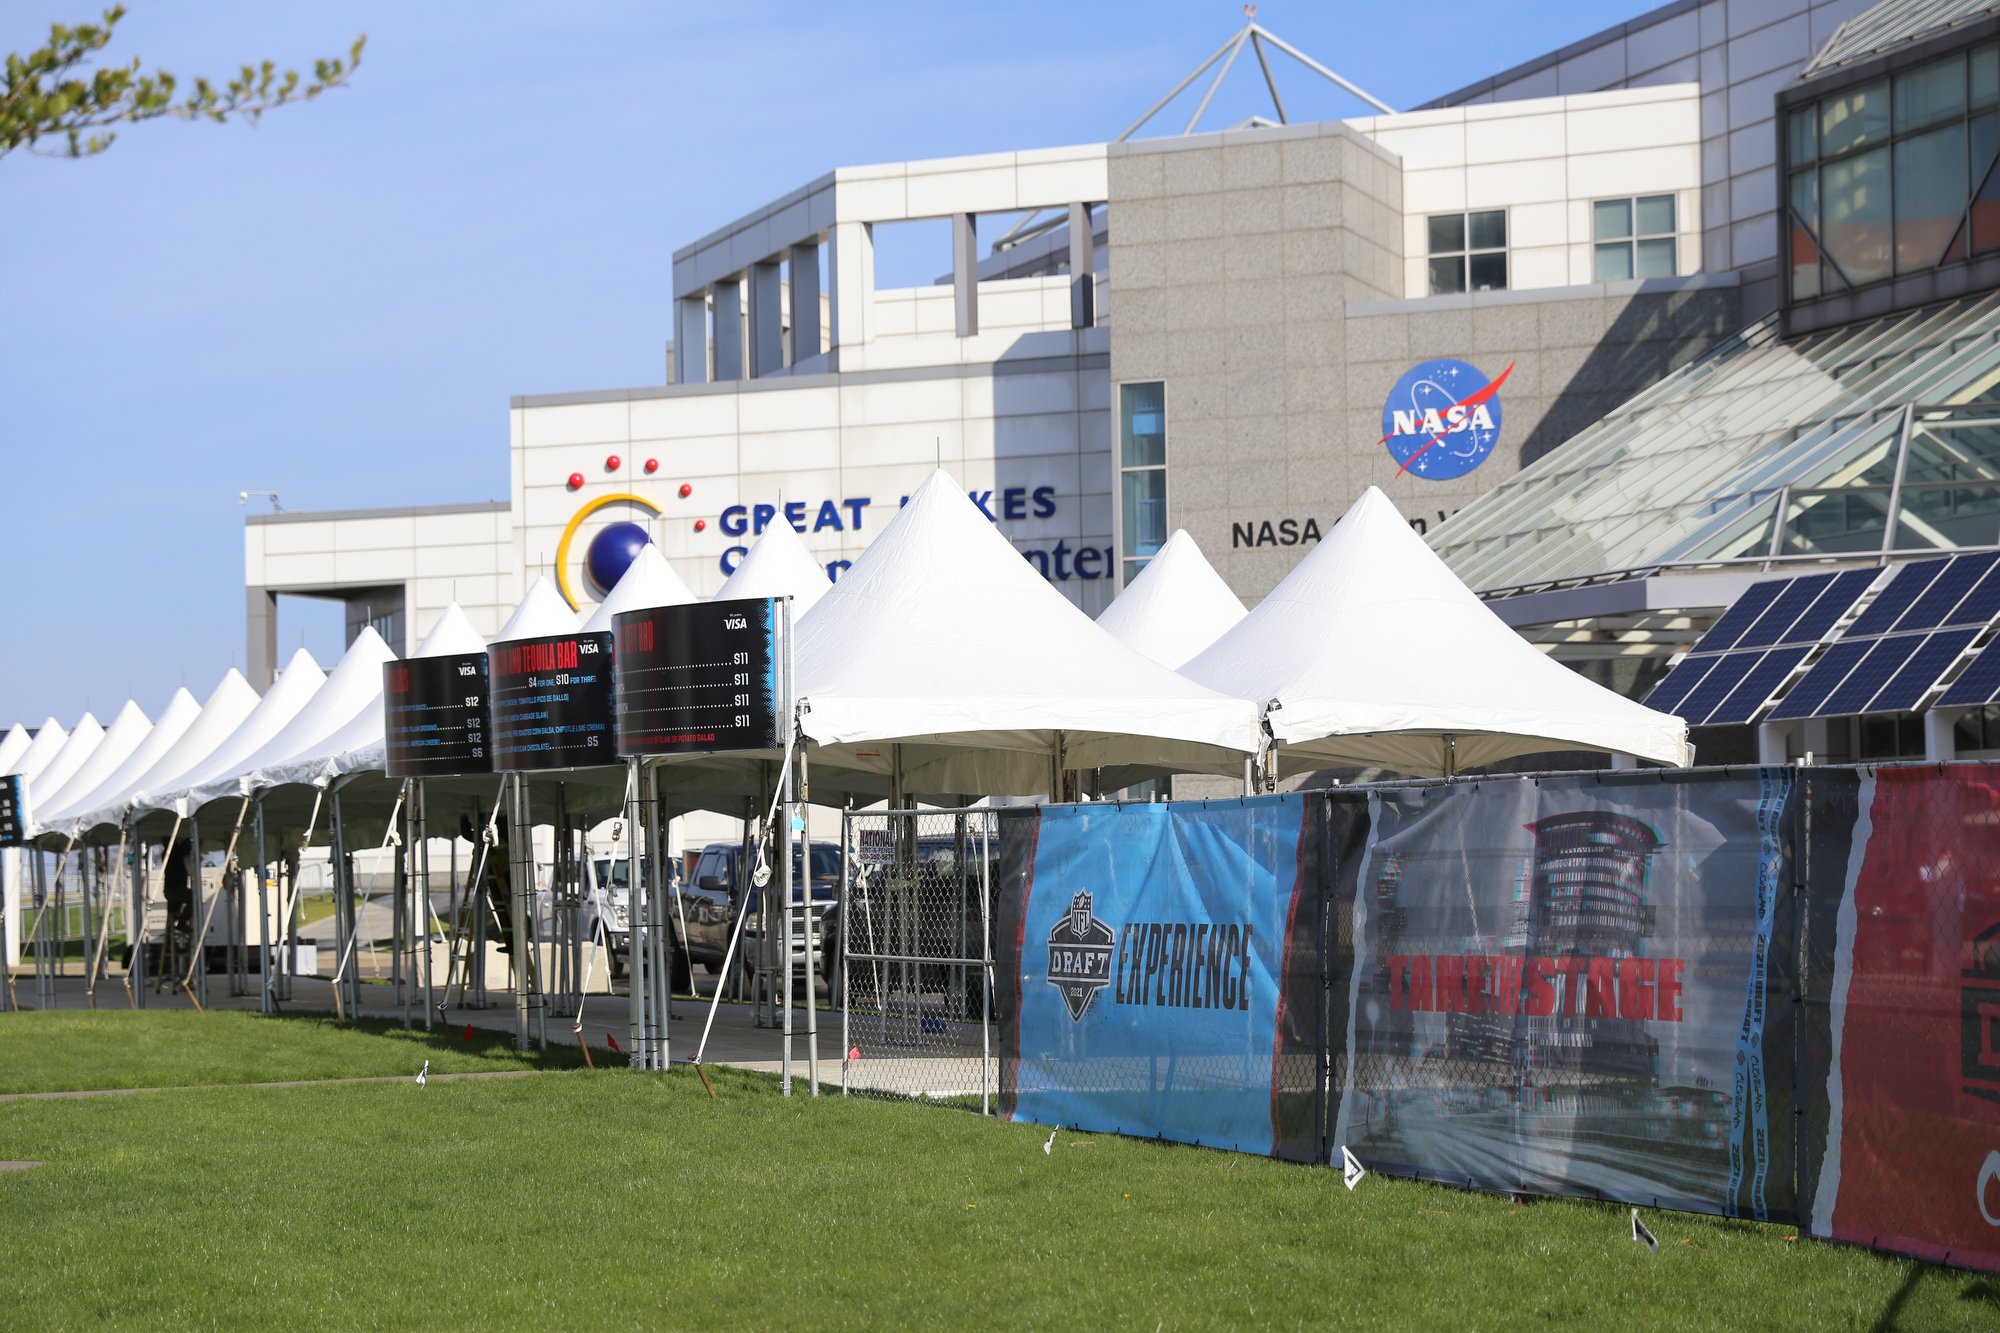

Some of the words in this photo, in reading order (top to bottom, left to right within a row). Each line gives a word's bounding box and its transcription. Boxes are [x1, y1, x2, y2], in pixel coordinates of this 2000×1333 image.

[1392, 404, 1495, 436] NASA
[720, 498, 871, 536] GREAT
[1232, 518, 1322, 548] NASA
[638, 620, 654, 652] BBQ
[723, 618, 748, 629] VISA
[522, 643, 556, 673] TEQUILA
[557, 640, 578, 670] BAR
[578, 643, 599, 654] VISA
[458, 666, 477, 675] VISA
[696, 733, 715, 741] SALAD
[860, 830, 895, 847] NATIONAL
[1073, 911, 1090, 931] NFL
[1051, 952, 1109, 974] DRAFT
[1116, 923, 1253, 1011] EXPERIENCE
[1070, 987, 1083, 998] 2021
[1386, 955, 1488, 1013] TAKE
[1524, 956, 1684, 1021] STAGE
[1754, 980, 1763, 1025] DRAFT
[1732, 1144, 1740, 1178] 2021
[1757, 1128, 1766, 1165] 2021
